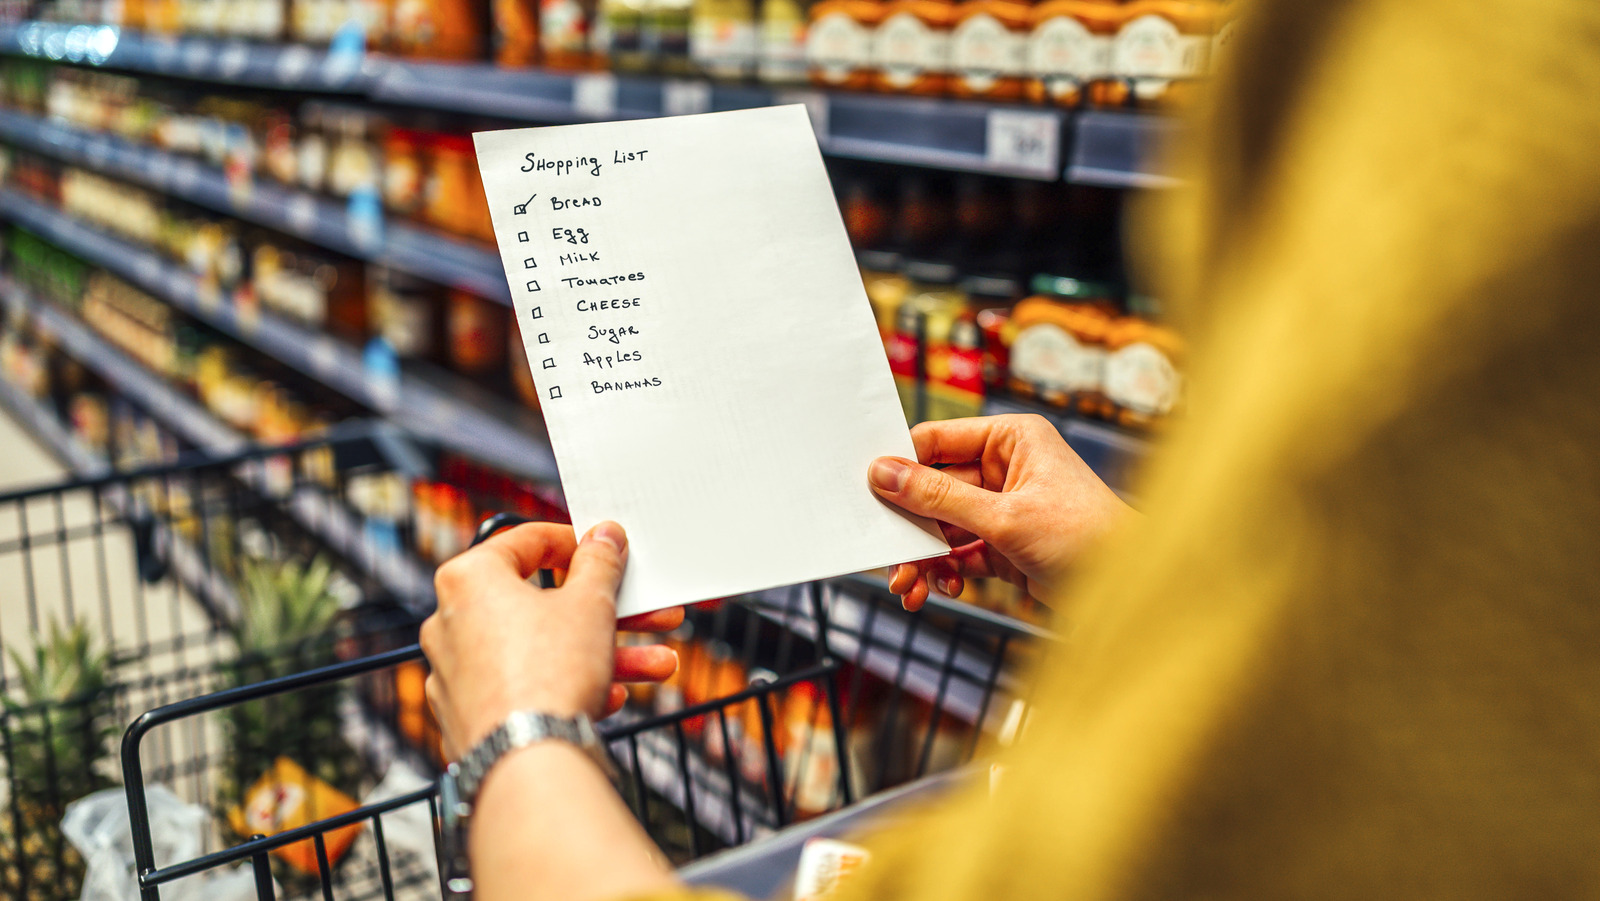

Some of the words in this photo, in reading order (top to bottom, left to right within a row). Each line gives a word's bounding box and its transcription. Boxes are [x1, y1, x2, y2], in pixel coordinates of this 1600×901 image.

[552, 227, 590, 245] Egg
[576, 297, 641, 312] CHEESE
[590, 377, 662, 394] BANANAS
